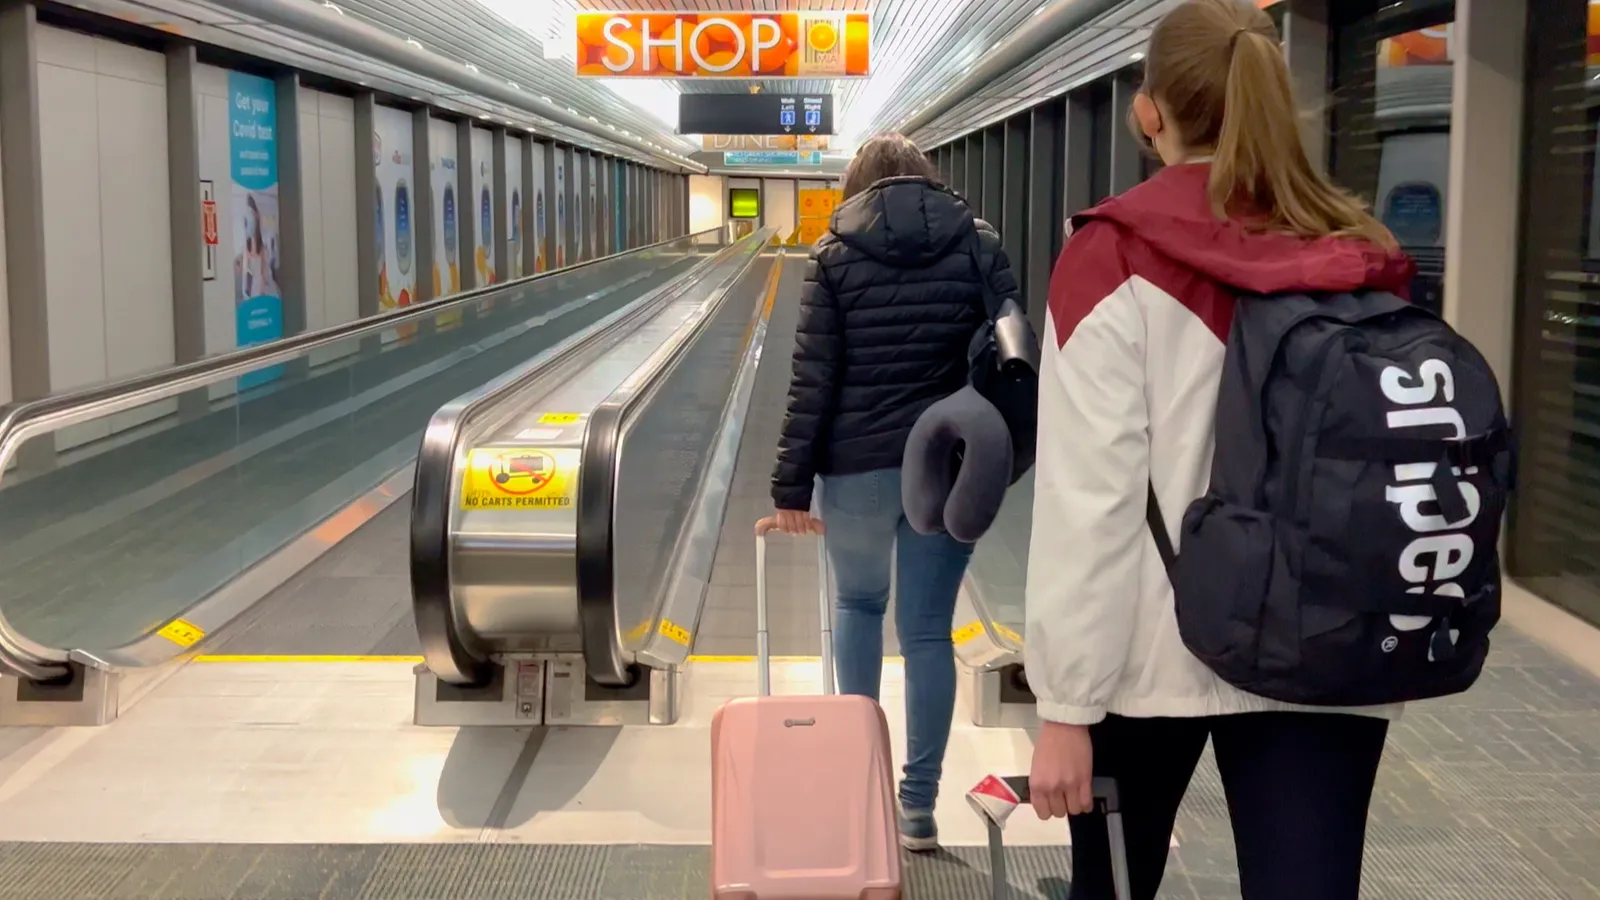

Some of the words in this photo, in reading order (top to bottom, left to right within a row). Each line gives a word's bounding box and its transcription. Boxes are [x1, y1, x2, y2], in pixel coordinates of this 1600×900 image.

[601, 18, 781, 72] SHOP
[236, 91, 251, 110] Get
[251, 98, 269, 115] your
[233, 119, 256, 138] Covid
[257, 124, 272, 140] test
[714, 134, 778, 149] DINE
[465, 495, 478, 506] NO
[482, 496, 512, 506] CARTS
[515, 496, 570, 506] PERMITTED
